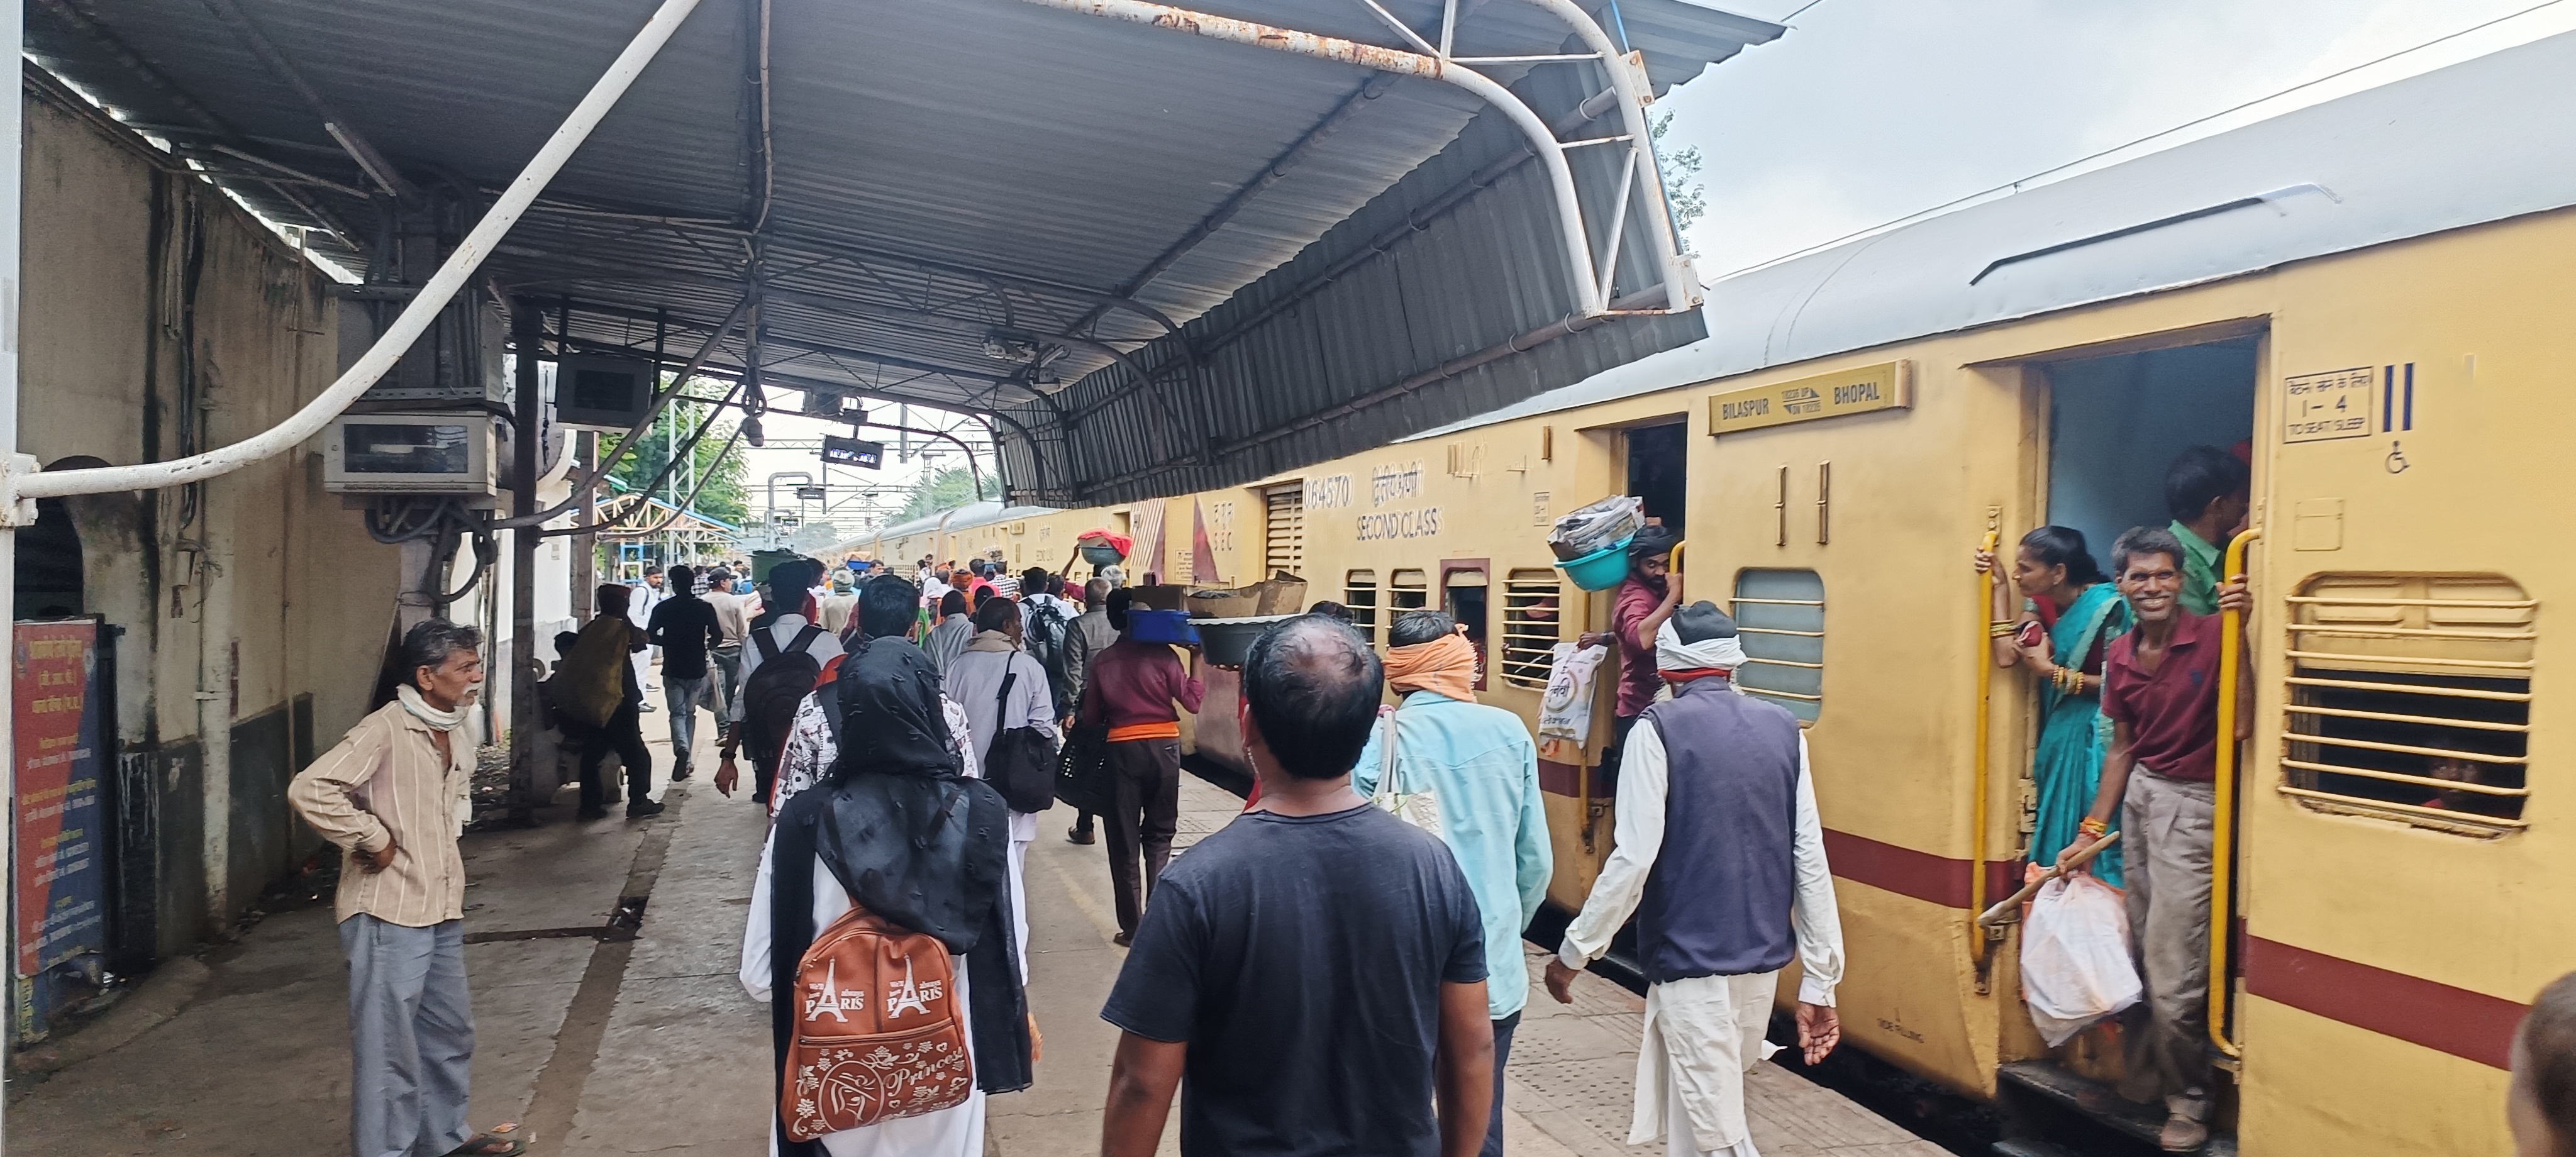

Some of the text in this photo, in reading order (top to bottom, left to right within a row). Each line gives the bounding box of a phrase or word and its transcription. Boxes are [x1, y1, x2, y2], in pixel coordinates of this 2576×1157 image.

[1834, 381, 1880, 405] BHOPAL
[1722, 398, 1770, 421] BILASPUR
[2287, 424, 2303, 436] TO
[1304, 475, 1352, 509] 064570
[1357, 507, 1443, 541] SECOND CLASS
